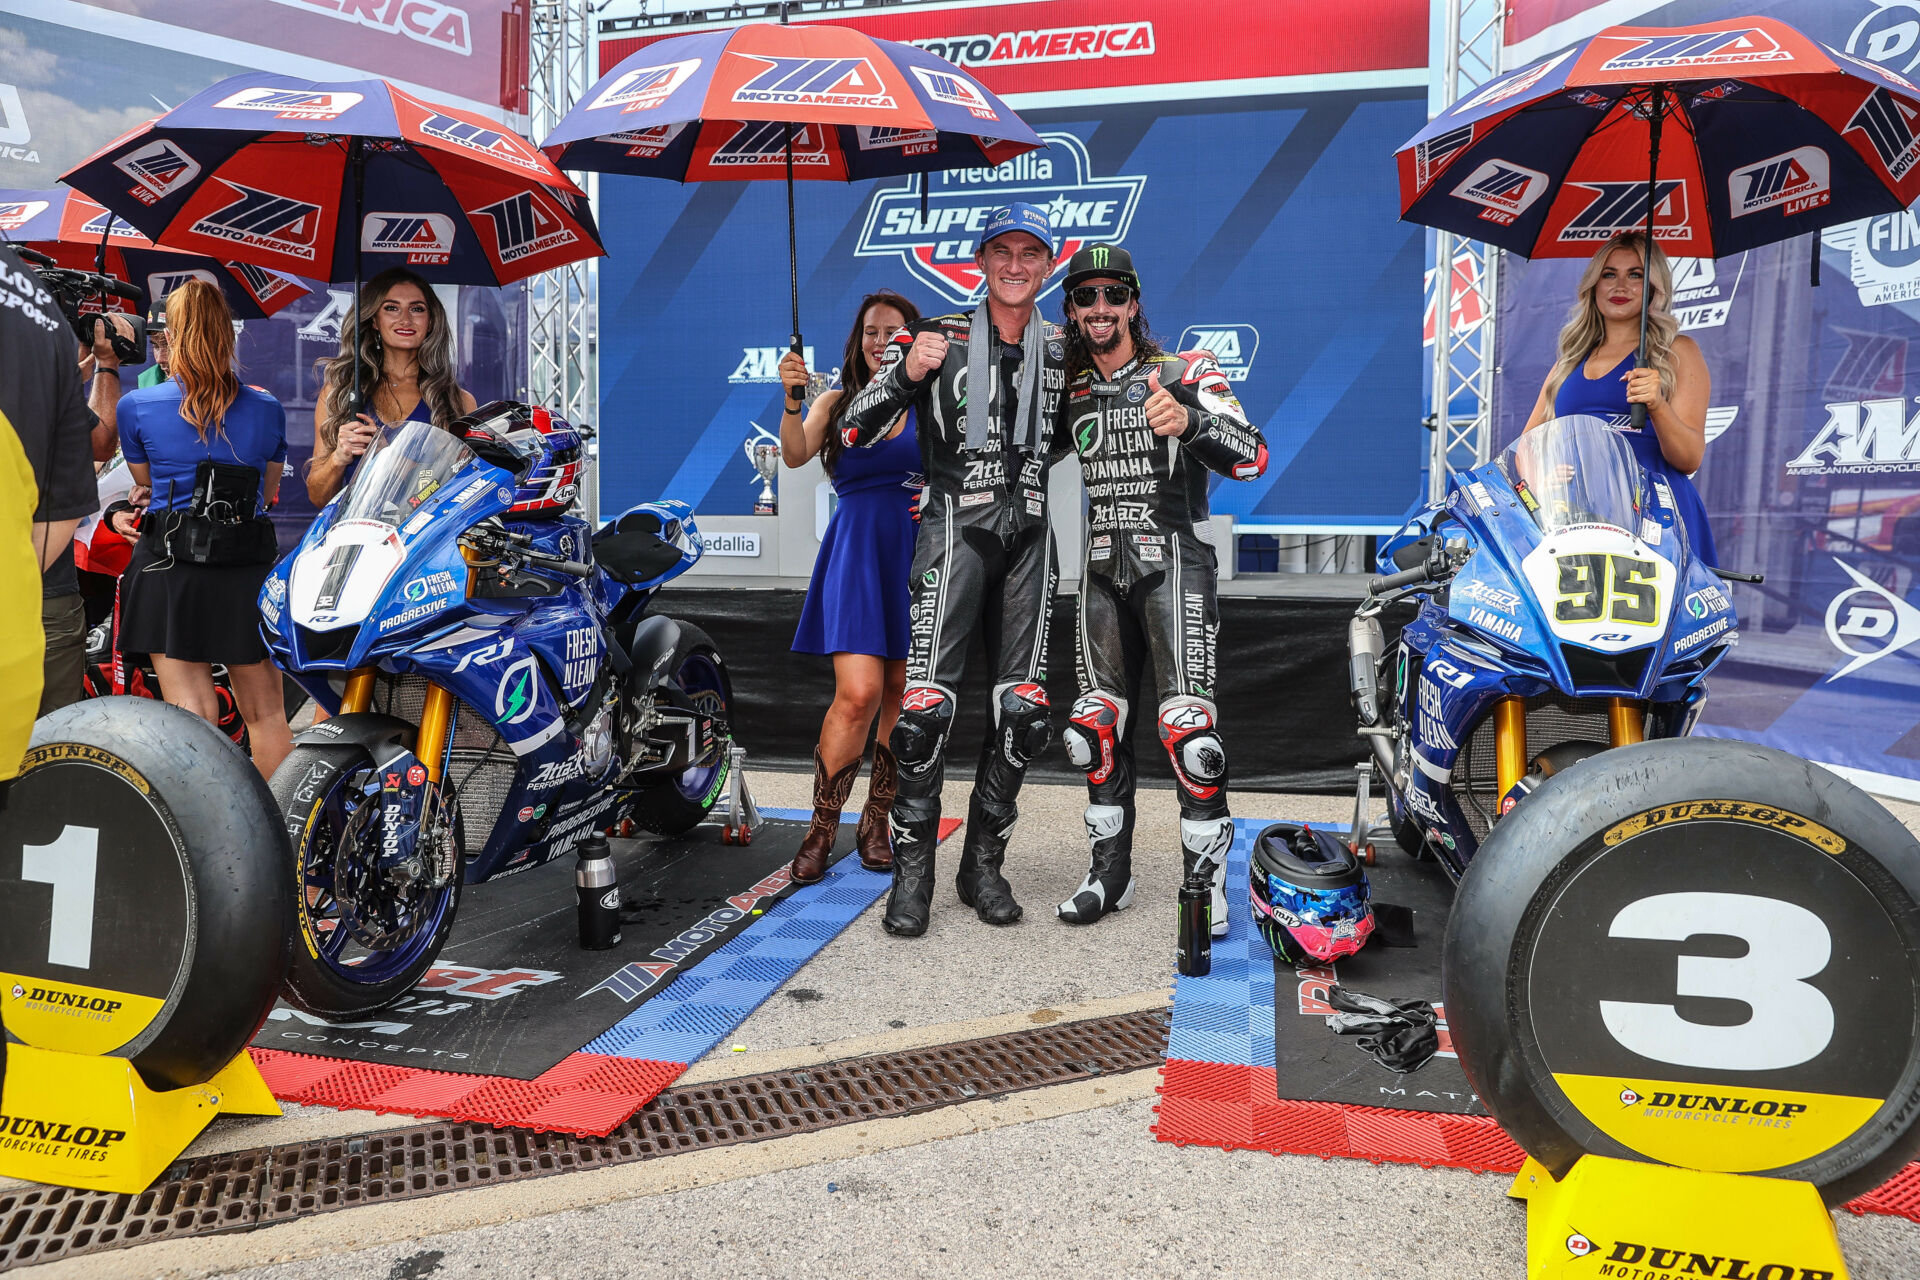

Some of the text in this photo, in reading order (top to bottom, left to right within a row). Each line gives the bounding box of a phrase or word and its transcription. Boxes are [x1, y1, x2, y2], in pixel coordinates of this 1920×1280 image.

[913, 26, 1151, 62] OTOAMERICA
[1605, 51, 1788, 69] MOTOAMERICA
[603, 87, 668, 104] MOTOAMERICA
[736, 91, 893, 107] MOTOAMERICA
[936, 92, 983, 106] MOTOAMERICA
[423, 127, 548, 173] MOTOAMERICA
[609, 131, 664, 144] MOTOAMERICA
[869, 132, 929, 145] MOTOAMERICA
[126, 161, 167, 192] MOTOAMERICA
[1464, 188, 1520, 210] MOTOAMERICA
[1743, 181, 1819, 210] MOTOAMERICA
[193, 221, 315, 260] MOTOAMERICA
[372, 241, 442, 249] MOTOAMERICA
[501, 229, 577, 262] MOTOAMERICA
[1874, 288, 1920, 303] AMERIC
[1112, 359, 1138, 379] alpines
[853, 386, 889, 416] YAMAHA
[1107, 406, 1148, 430] FRESH
[1220, 431, 1256, 461] YAMAHA
[1090, 457, 1154, 481] YAMAHA
[553, 484, 578, 501] Arai
[1092, 501, 1159, 529] Attack
[1569, 524, 1631, 538] MOTOAMERICA
[427, 571, 451, 587] FRESH
[438, 580, 458, 595] LEAN
[1554, 552, 1661, 627] 95
[317, 596, 334, 607] 32
[1463, 579, 1523, 617] Attack
[380, 597, 448, 633] PROGRESSIVE
[915, 591, 937, 635] FRESH
[1467, 605, 1523, 643] YAMAHA
[566, 626, 598, 661] FRESH
[1673, 617, 1729, 655] PROGRESSIVE
[571, 656, 597, 689] LEAN
[1186, 638, 1205, 680] FRESH
[1418, 673, 1444, 723] FRESH
[312, 722, 345, 735] AMAHA
[34, 743, 128, 773] DUNLOP
[1644, 802, 1807, 829] DUNLOP
[382, 803, 400, 858] DUNLOP
[22, 824, 100, 969] 1
[1599, 891, 1835, 1071] 3
[24, 1001, 113, 1023] MOTORCYCLE TIRES
[28, 987, 122, 1014] DUNLOP
[281, 1031, 471, 1060] CONCEPTS
[1643, 1107, 1792, 1130] MOTORCYCLE TIRES
[1648, 1091, 1808, 1119] DUNLOP
[67, 1144, 109, 1163] TIRES
